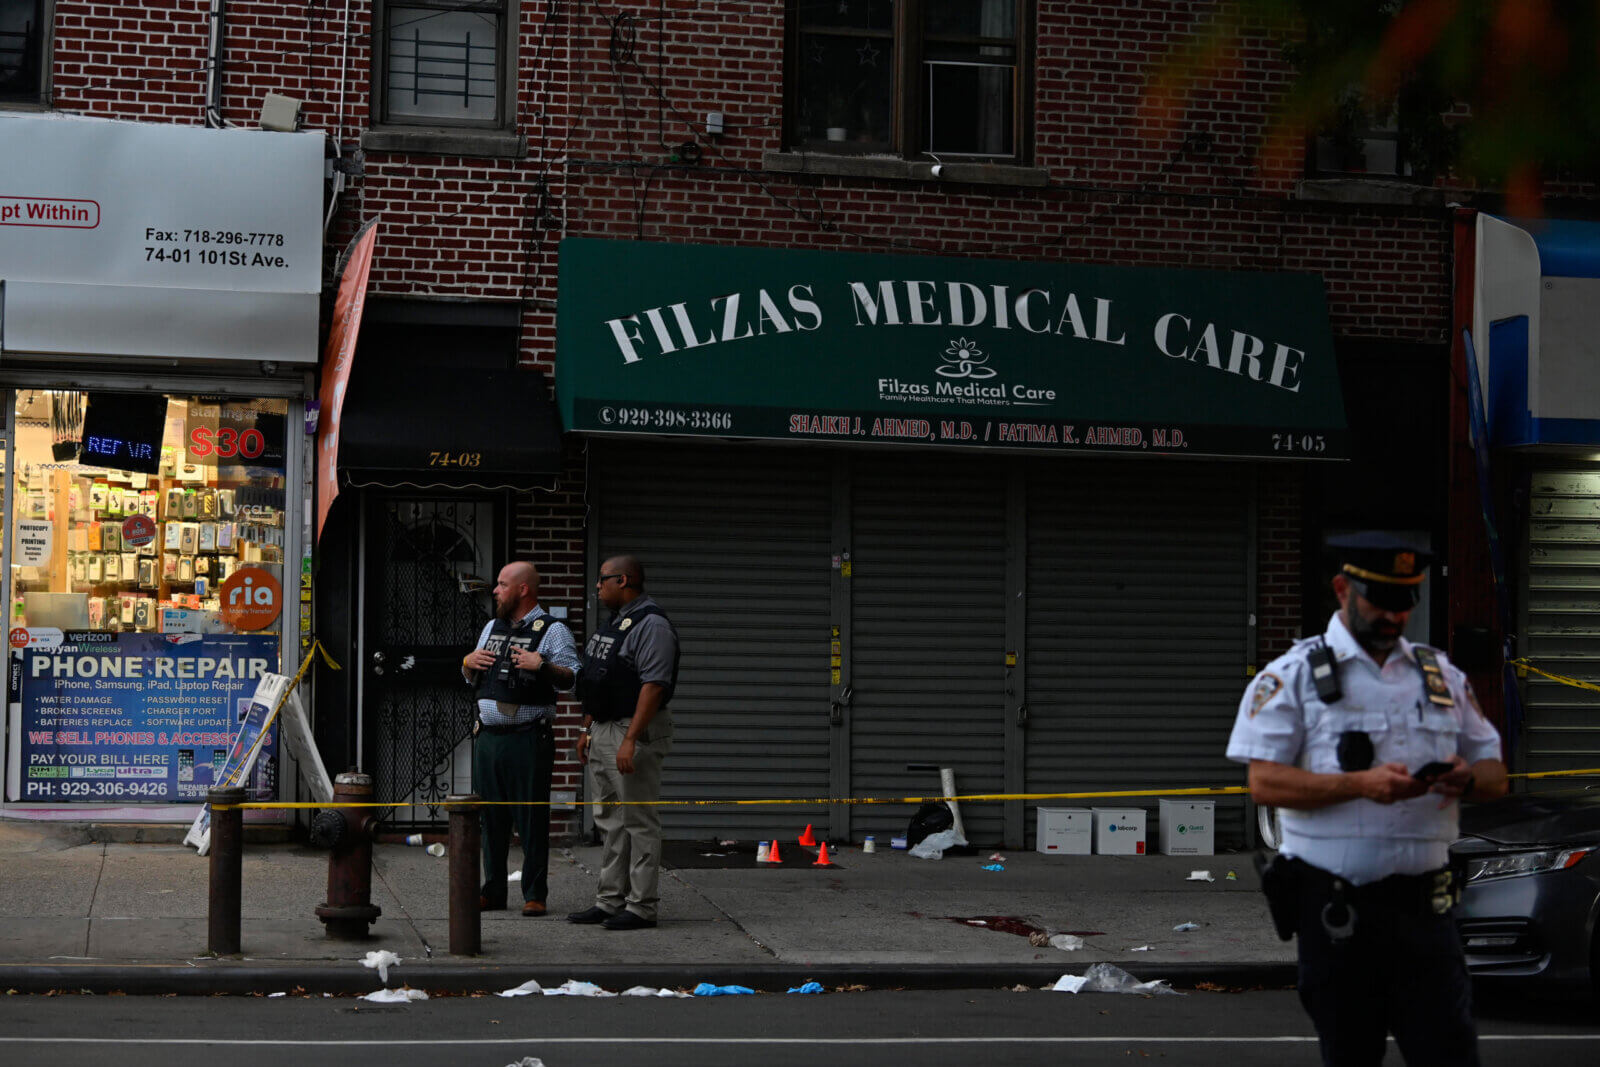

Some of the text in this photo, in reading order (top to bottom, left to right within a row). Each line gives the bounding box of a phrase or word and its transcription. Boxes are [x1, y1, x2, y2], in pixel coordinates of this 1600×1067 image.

[26, 203, 88, 221] Within
[145, 228, 284, 247] Fax: 718-296-7778
[145, 247, 289, 268] 74-01 101St Ave.
[604, 279, 1305, 393] FILZAS MEDICAL CARE
[878, 379, 1056, 400] Filzas Medical Care
[879, 394, 1010, 405] Family Healthcare That Matters
[618, 407, 732, 430] 929-398-3366
[789, 414, 850, 434] SHAIKH
[852, 417, 866, 435] J.
[871, 417, 936, 441] AHMED,
[940, 421, 978, 440] M.D.
[999, 423, 1058, 443] FATIMA
[1063, 425, 1080, 444] K.
[1084, 426, 1147, 448] AHMED,
[1152, 428, 1188, 447] M.D.
[189, 425, 265, 460] $30
[1271, 433, 1326, 452] 74-05
[429, 451, 481, 467] 74-03
[229, 576, 273, 605] ria
[11, 630, 27, 641] ria
[69, 631, 112, 642] verizon
[32, 655, 143, 678] PHONE
[155, 657, 268, 679] REPAIR
[54, 680, 244, 691] iPhone, Samsung, iPad, Laptop Repair
[41, 696, 113, 704] WATER DAMAGE
[40, 707, 123, 715] BROKEN SCREENS
[40, 718, 89, 726] BATTERIES
[147, 718, 195, 726] SOFTWARE
[29, 731, 272, 746] WE SELL PHONES & ACCESSOS
[30, 754, 170, 765] PAY YOUR BILL HERE
[27, 782, 168, 796] PH: 929-306-9426
[1188, 824, 1205, 832] Quest
